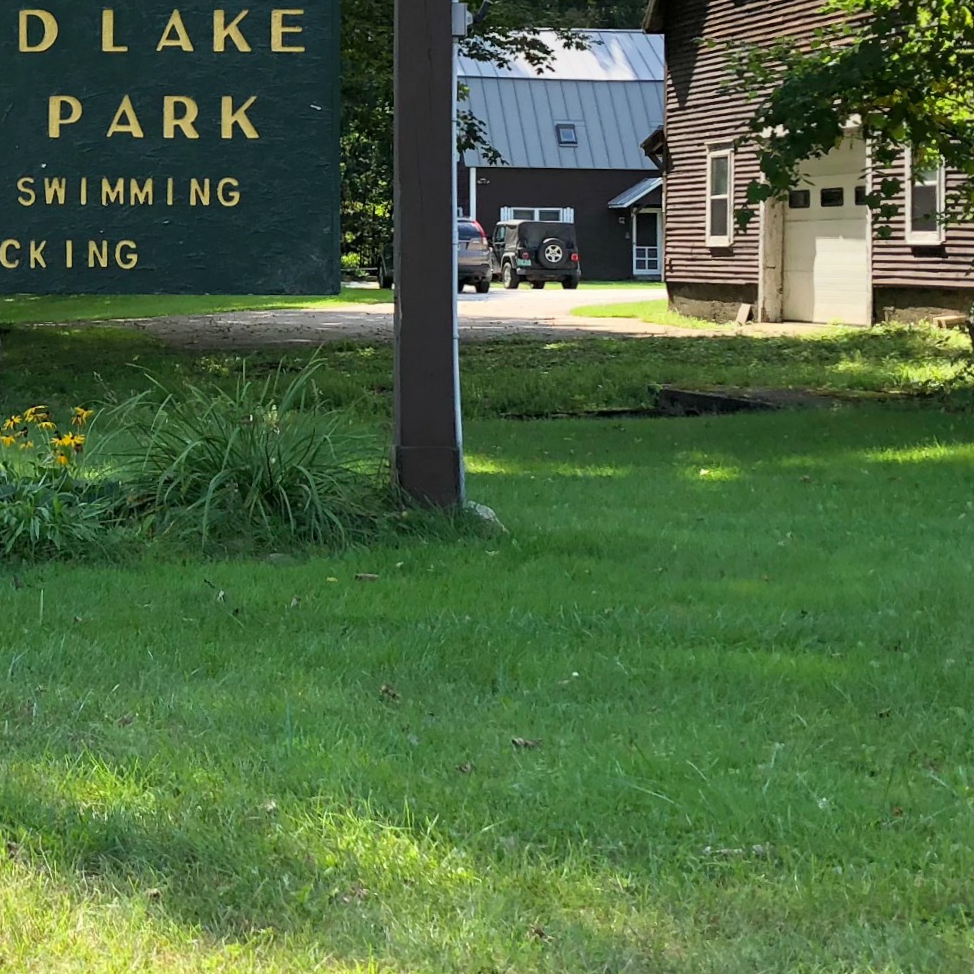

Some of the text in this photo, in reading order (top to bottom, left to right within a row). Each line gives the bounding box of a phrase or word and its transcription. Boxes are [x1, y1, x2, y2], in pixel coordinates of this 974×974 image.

[101, 8, 306, 53] LAKE
[48, 95, 259, 139] PARK
[17, 177, 241, 207] SWIMMING
